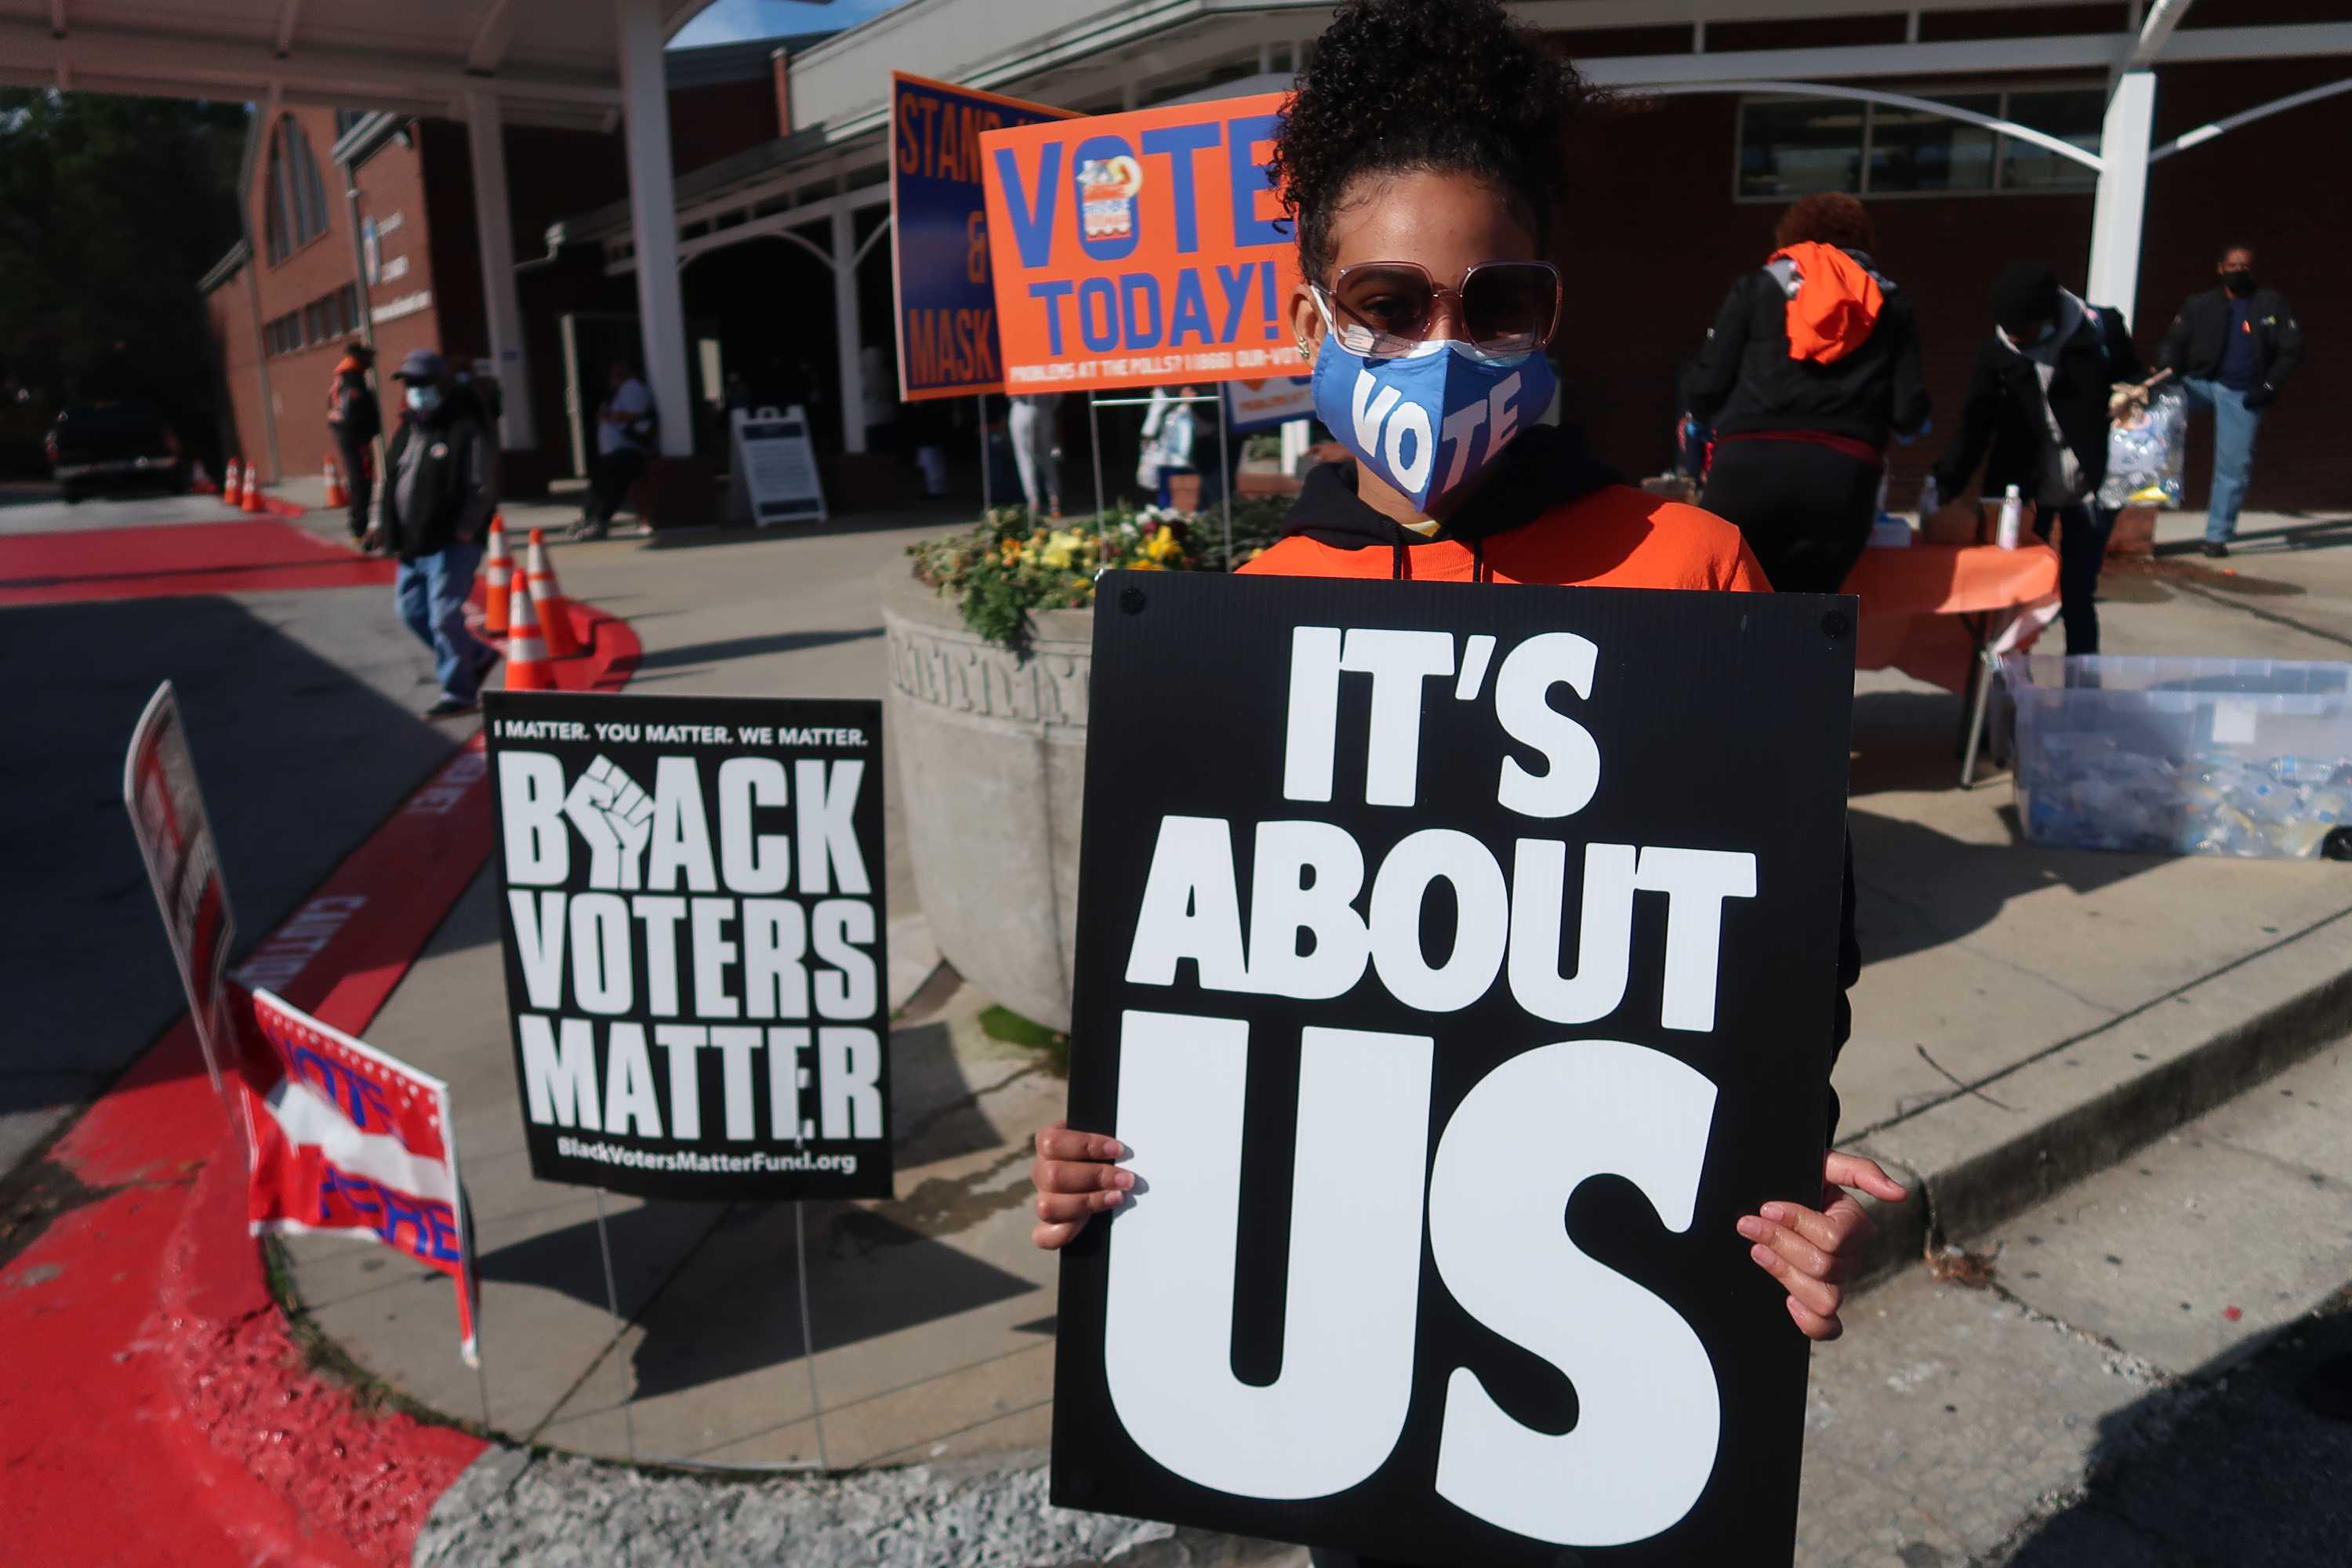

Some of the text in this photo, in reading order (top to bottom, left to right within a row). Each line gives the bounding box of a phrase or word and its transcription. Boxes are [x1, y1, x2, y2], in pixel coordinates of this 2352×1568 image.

[900, 92, 1002, 185] STAN
[993, 113, 1298, 269] VOTE
[1028, 260, 1280, 355] TODAY!
[1079, 361, 1097, 378] AT
[1102, 358, 1128, 376] THE
[1236, 347, 1302, 368] OUR-VOT
[1352, 368, 1523, 494] VOTE
[494, 720, 868, 746] I MATTER. YOU MATTER. WE MATTER.
[1283, 626, 1601, 818] IT'S
[507, 889, 877, 1020] VOTERS
[1124, 815, 1758, 1033] ABOUT
[518, 1014, 883, 1141] MATTER
[557, 1137, 857, 1175] BlackVotersMatterFund.org
[1102, 1009, 1721, 1548] US
